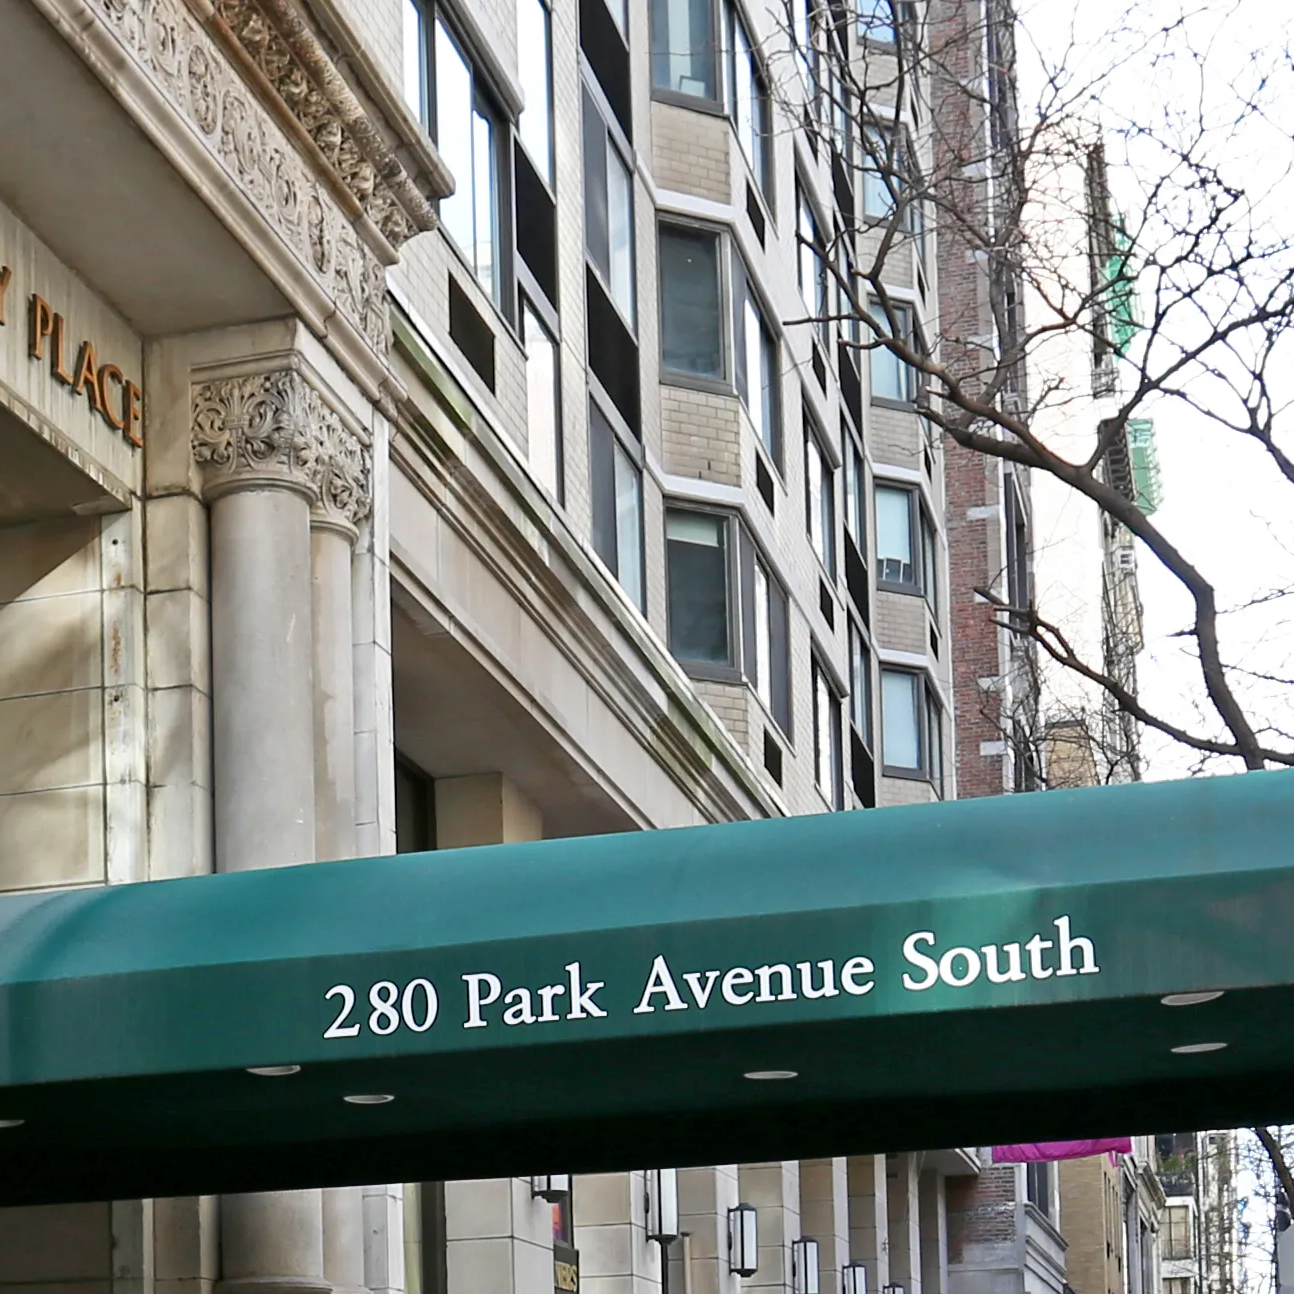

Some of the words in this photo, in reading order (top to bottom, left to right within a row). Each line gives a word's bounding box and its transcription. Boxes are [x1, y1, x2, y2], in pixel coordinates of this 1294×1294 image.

[28, 293, 143, 448] PLACE
[323, 978, 439, 1040] 280
[462, 963, 607, 1029] Park
[634, 955, 876, 1014] Avenue
[902, 916, 1101, 992] South
